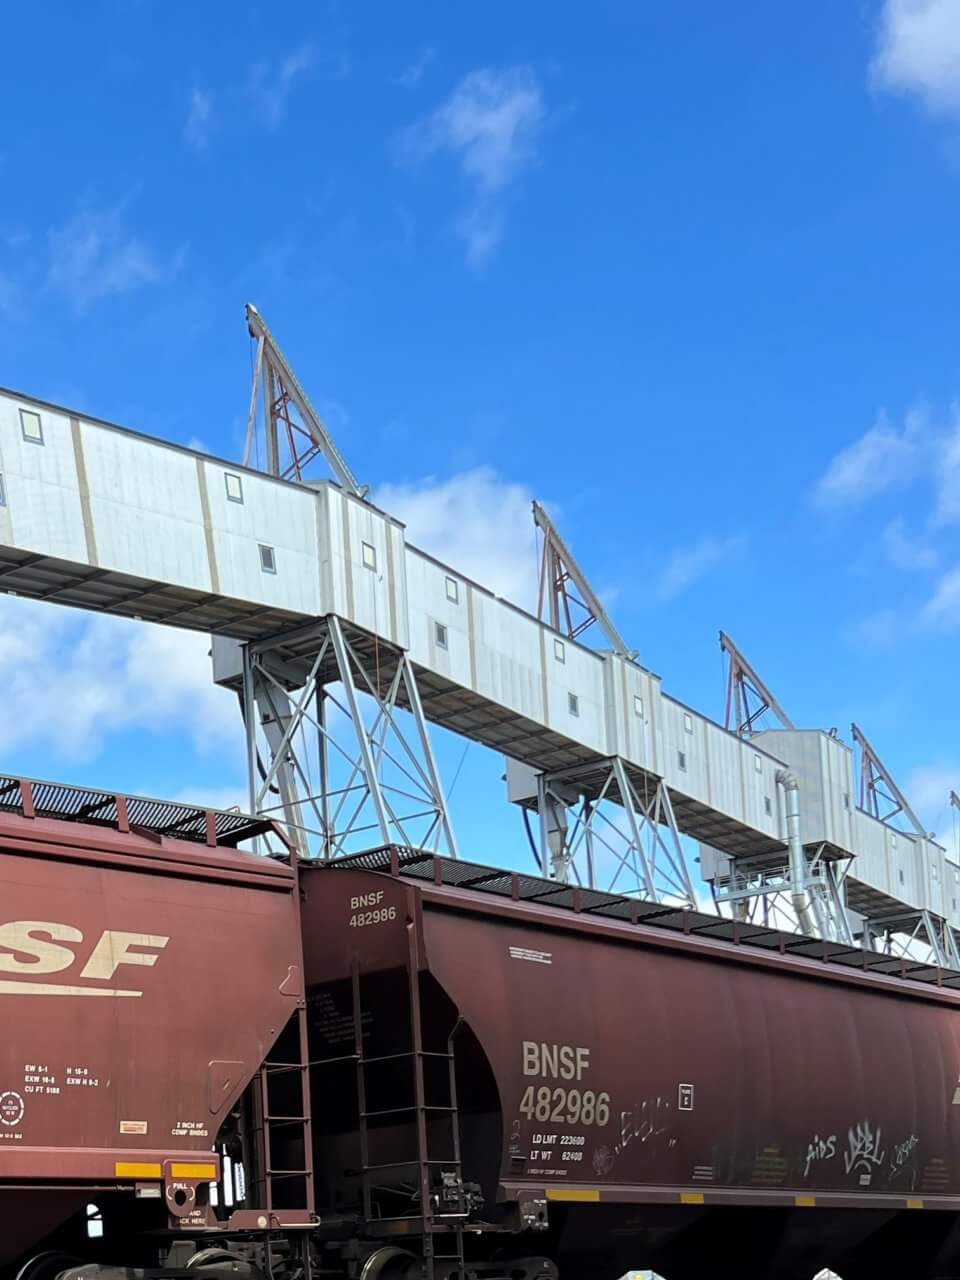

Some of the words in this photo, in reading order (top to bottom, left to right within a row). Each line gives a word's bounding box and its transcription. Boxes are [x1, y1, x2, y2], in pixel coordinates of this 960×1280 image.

[351, 890, 384, 909] BNSF
[349, 906, 396, 927] 482986
[522, 1040, 590, 1080] BNSF
[519, 1086, 610, 1126] 482986
[532, 1134, 542, 1144] LD
[542, 1134, 558, 1145] LMT
[530, 1150, 539, 1160] LT
[541, 1151, 552, 1161] WT
